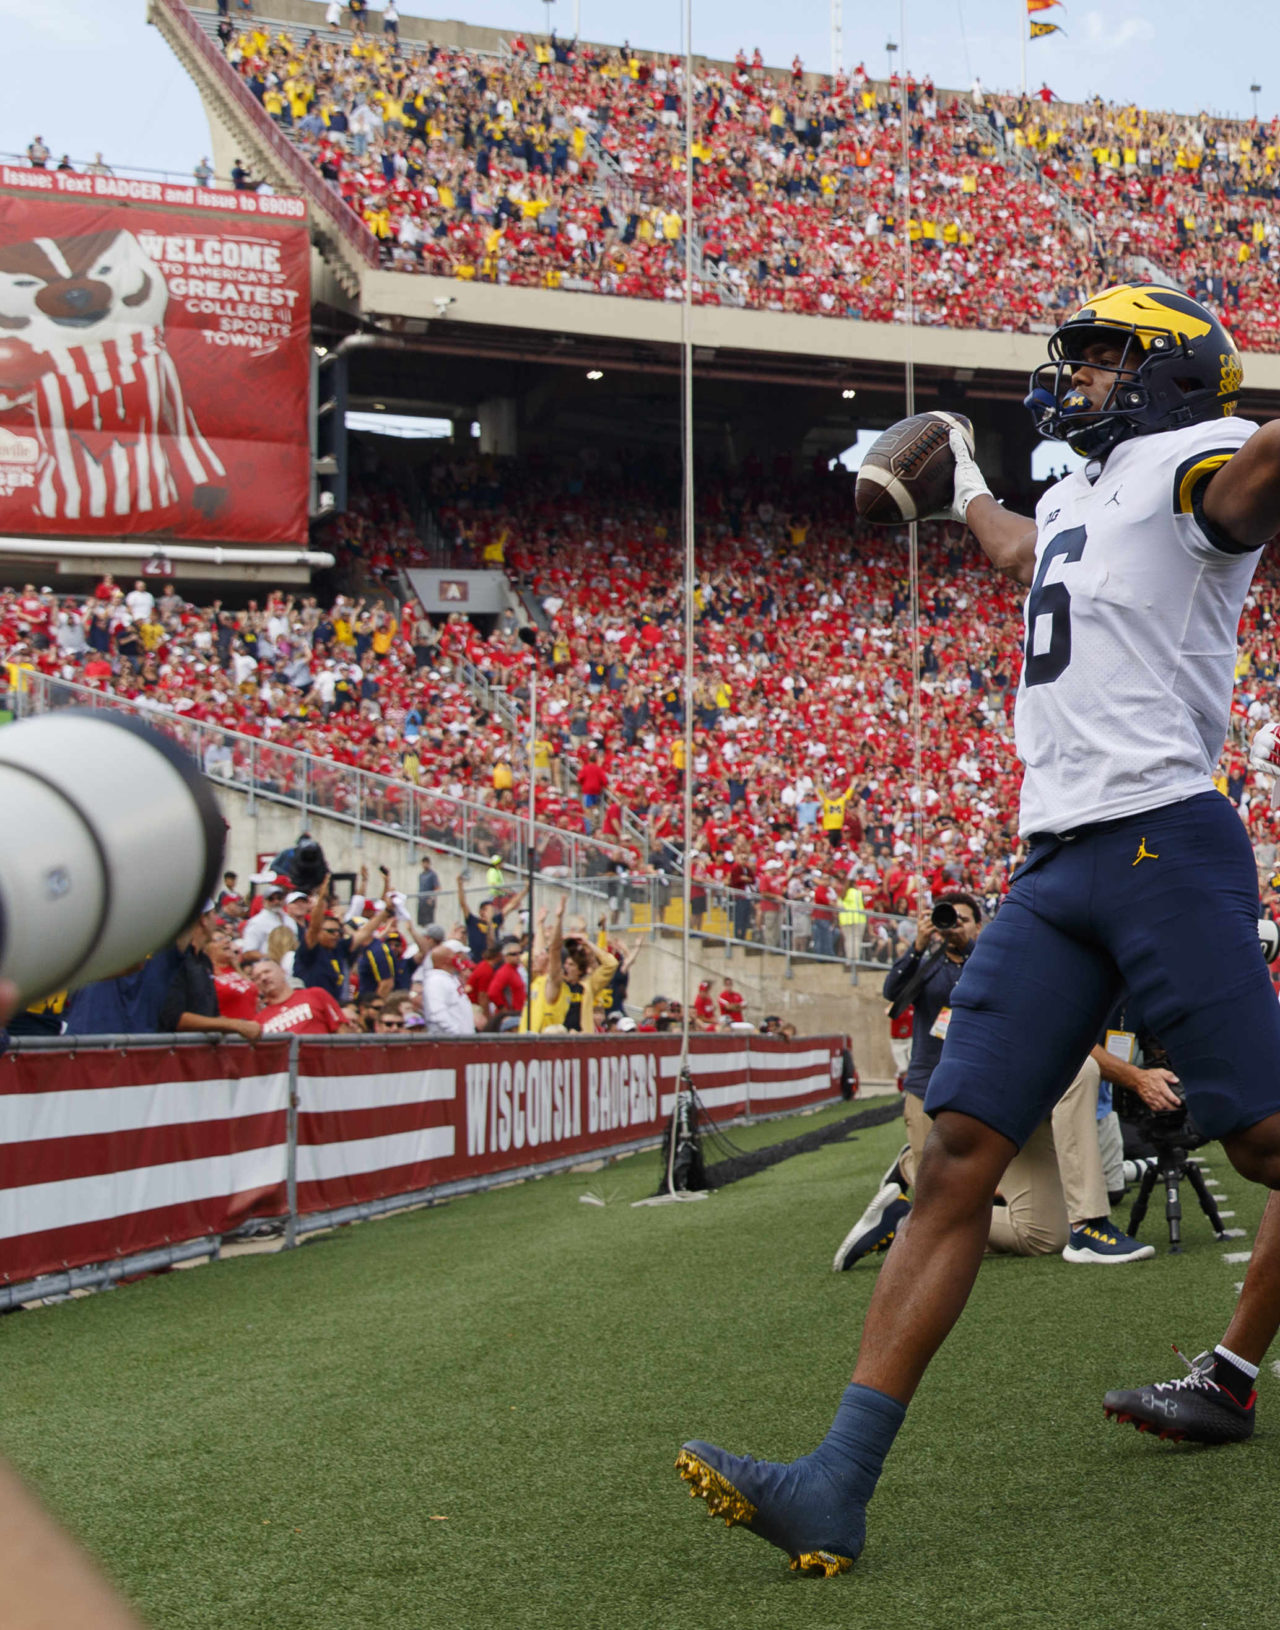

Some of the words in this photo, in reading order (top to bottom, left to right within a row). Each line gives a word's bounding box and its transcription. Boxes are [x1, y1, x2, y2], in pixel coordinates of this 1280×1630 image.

[55, 172, 93, 193] Text
[94, 177, 163, 201] BADGER
[164, 187, 194, 204] and
[239, 194, 257, 211] to
[259, 196, 305, 217] 69050
[137, 234, 282, 272] WELCOME
[160, 262, 184, 275] TO
[168, 277, 300, 307] GREATEST
[185, 300, 275, 320] COLLEGE
[218, 317, 292, 338] SPORTS
[202, 329, 263, 349] TOWN
[446, 583, 461, 600] A
[1025, 524, 1088, 688] 6
